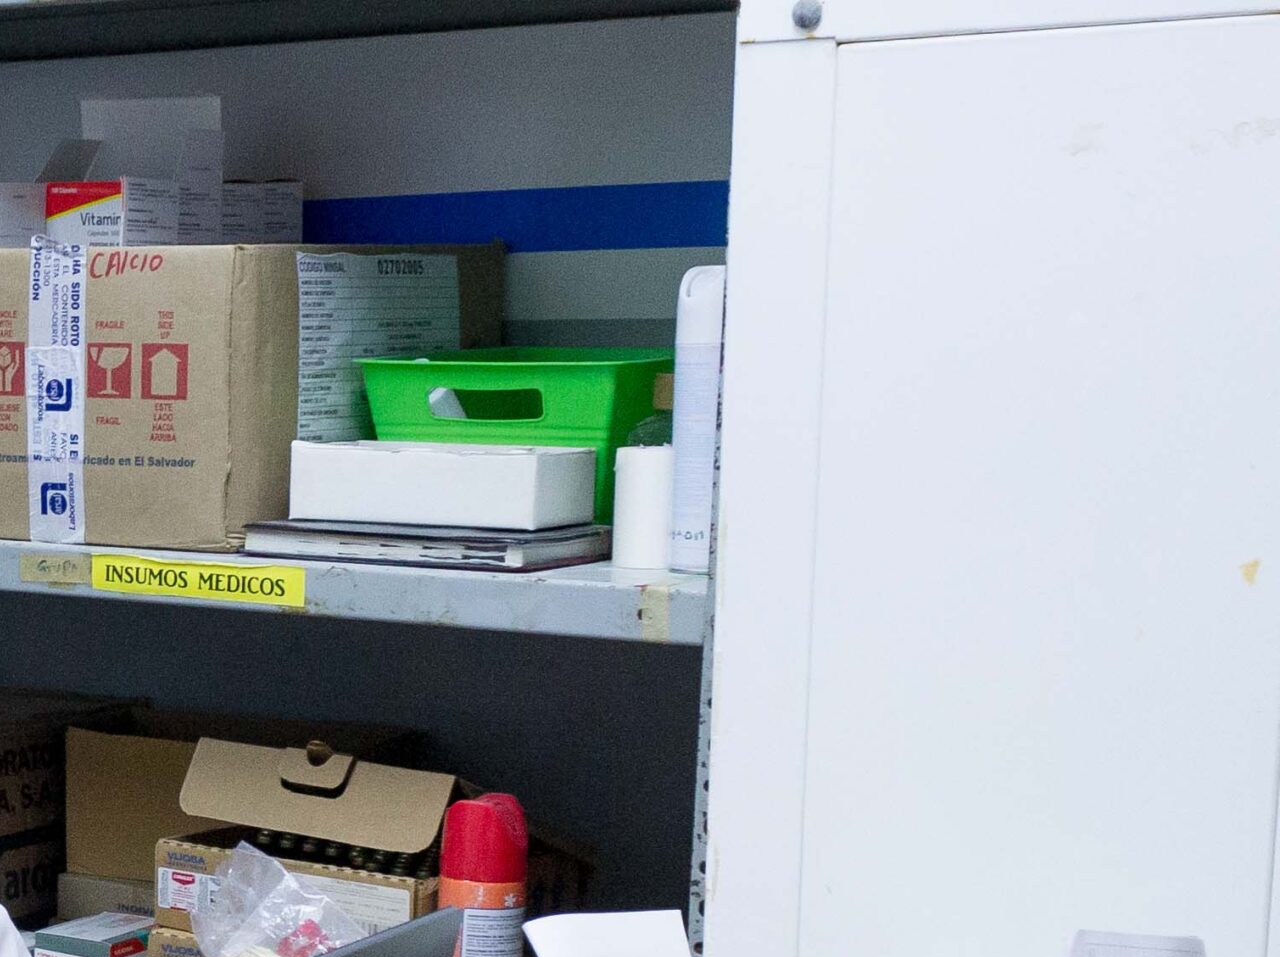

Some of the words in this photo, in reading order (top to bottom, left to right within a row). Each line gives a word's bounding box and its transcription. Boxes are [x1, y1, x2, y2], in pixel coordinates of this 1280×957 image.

[52, 258, 60, 278] ESTA
[62, 265, 69, 275] EL
[72, 259, 81, 275] HA
[70, 281, 80, 310] SIDO
[61, 284, 69, 347] CONTENIDO
[95, 320, 125, 329] FRAGILE
[70, 315, 80, 347] ROTO
[150, 433, 177, 442] ARRIBA
[83, 456, 115, 467] ricado
[119, 458, 131, 466] en
[134, 457, 144, 467] El
[148, 457, 195, 469] Salvador
[104, 564, 188, 589] INSUMOS
[198, 573, 286, 597] MEDICOS
